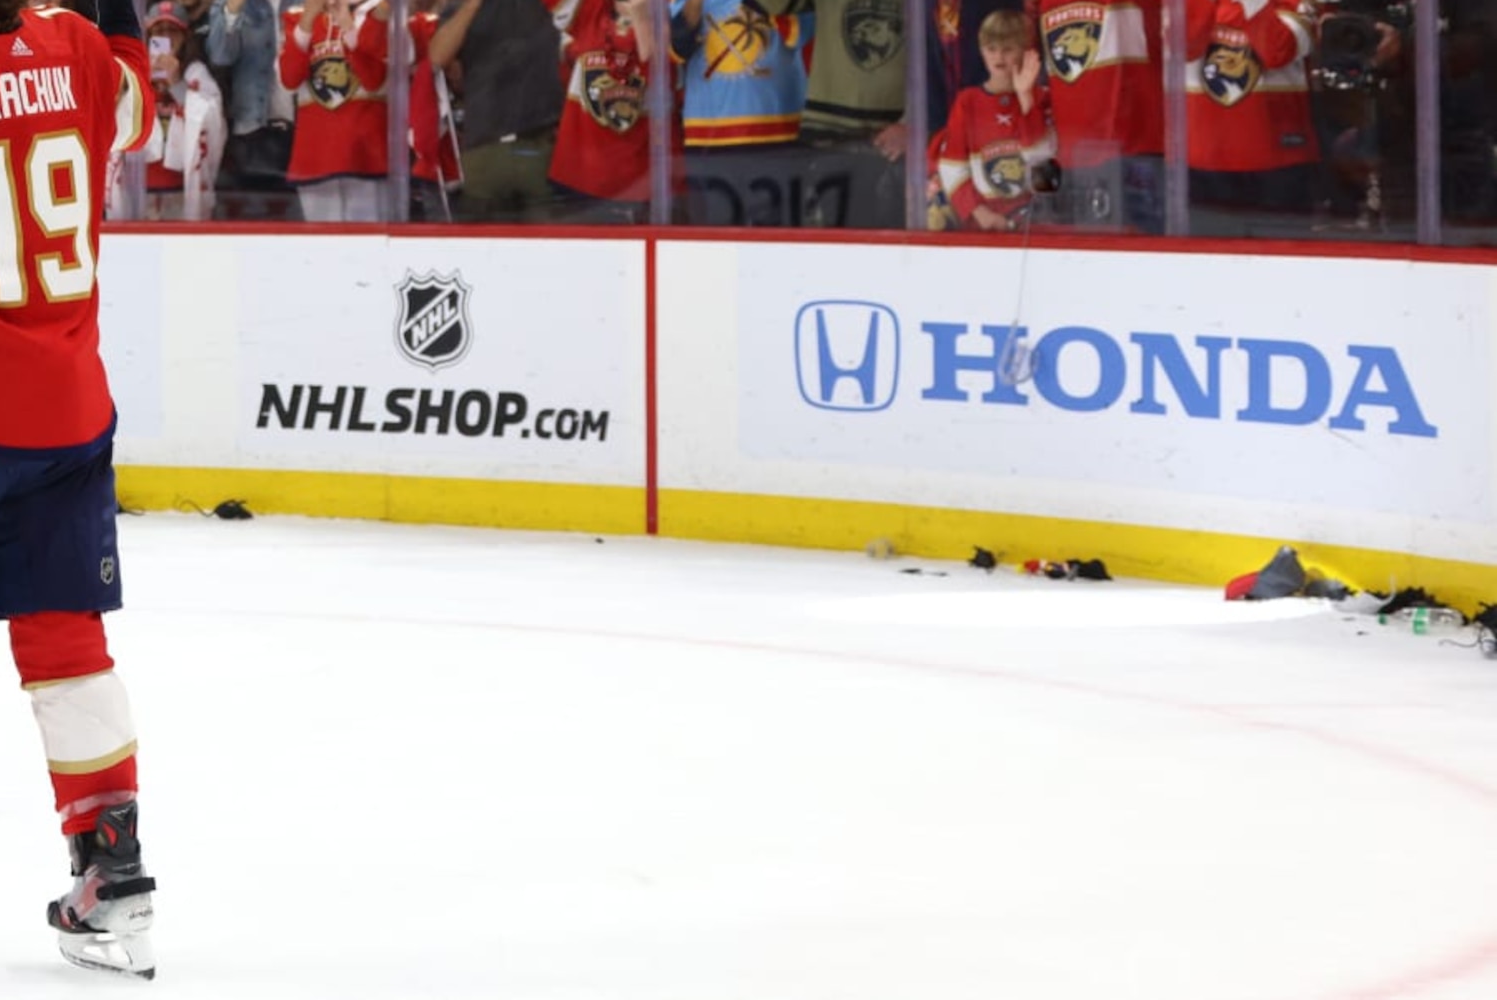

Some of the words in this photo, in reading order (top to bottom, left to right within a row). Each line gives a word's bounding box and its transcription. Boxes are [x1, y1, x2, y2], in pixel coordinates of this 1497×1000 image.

[1047, 7, 1101, 23] PANTHERS
[409, 298, 459, 348] NHL
[920, 321, 1439, 438] HONDA
[256, 383, 610, 442] NHLSHOP.COM
